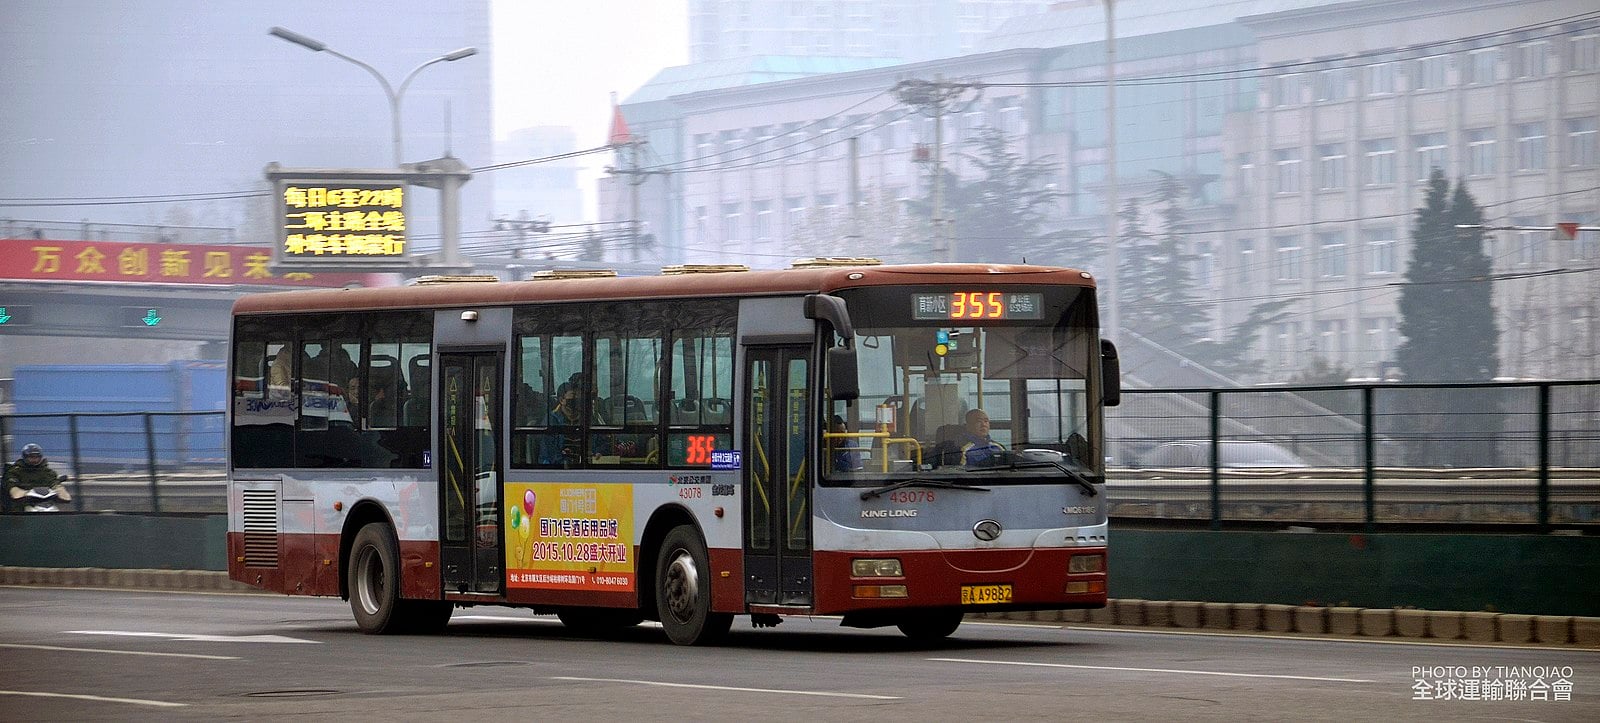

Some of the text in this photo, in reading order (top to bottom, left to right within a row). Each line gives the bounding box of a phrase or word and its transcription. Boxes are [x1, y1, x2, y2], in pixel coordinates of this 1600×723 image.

[31, 246, 314, 281] 万众创新见未
[951, 292, 1003, 318] 355
[686, 435, 715, 464] 355
[679, 487, 702, 499] 43078
[890, 491, 935, 503] 43078
[861, 509, 917, 518] KING LONG
[540, 518, 617, 538] 国门1号酒店用品城
[533, 542, 626, 562] 2015.10.28盛大开业
